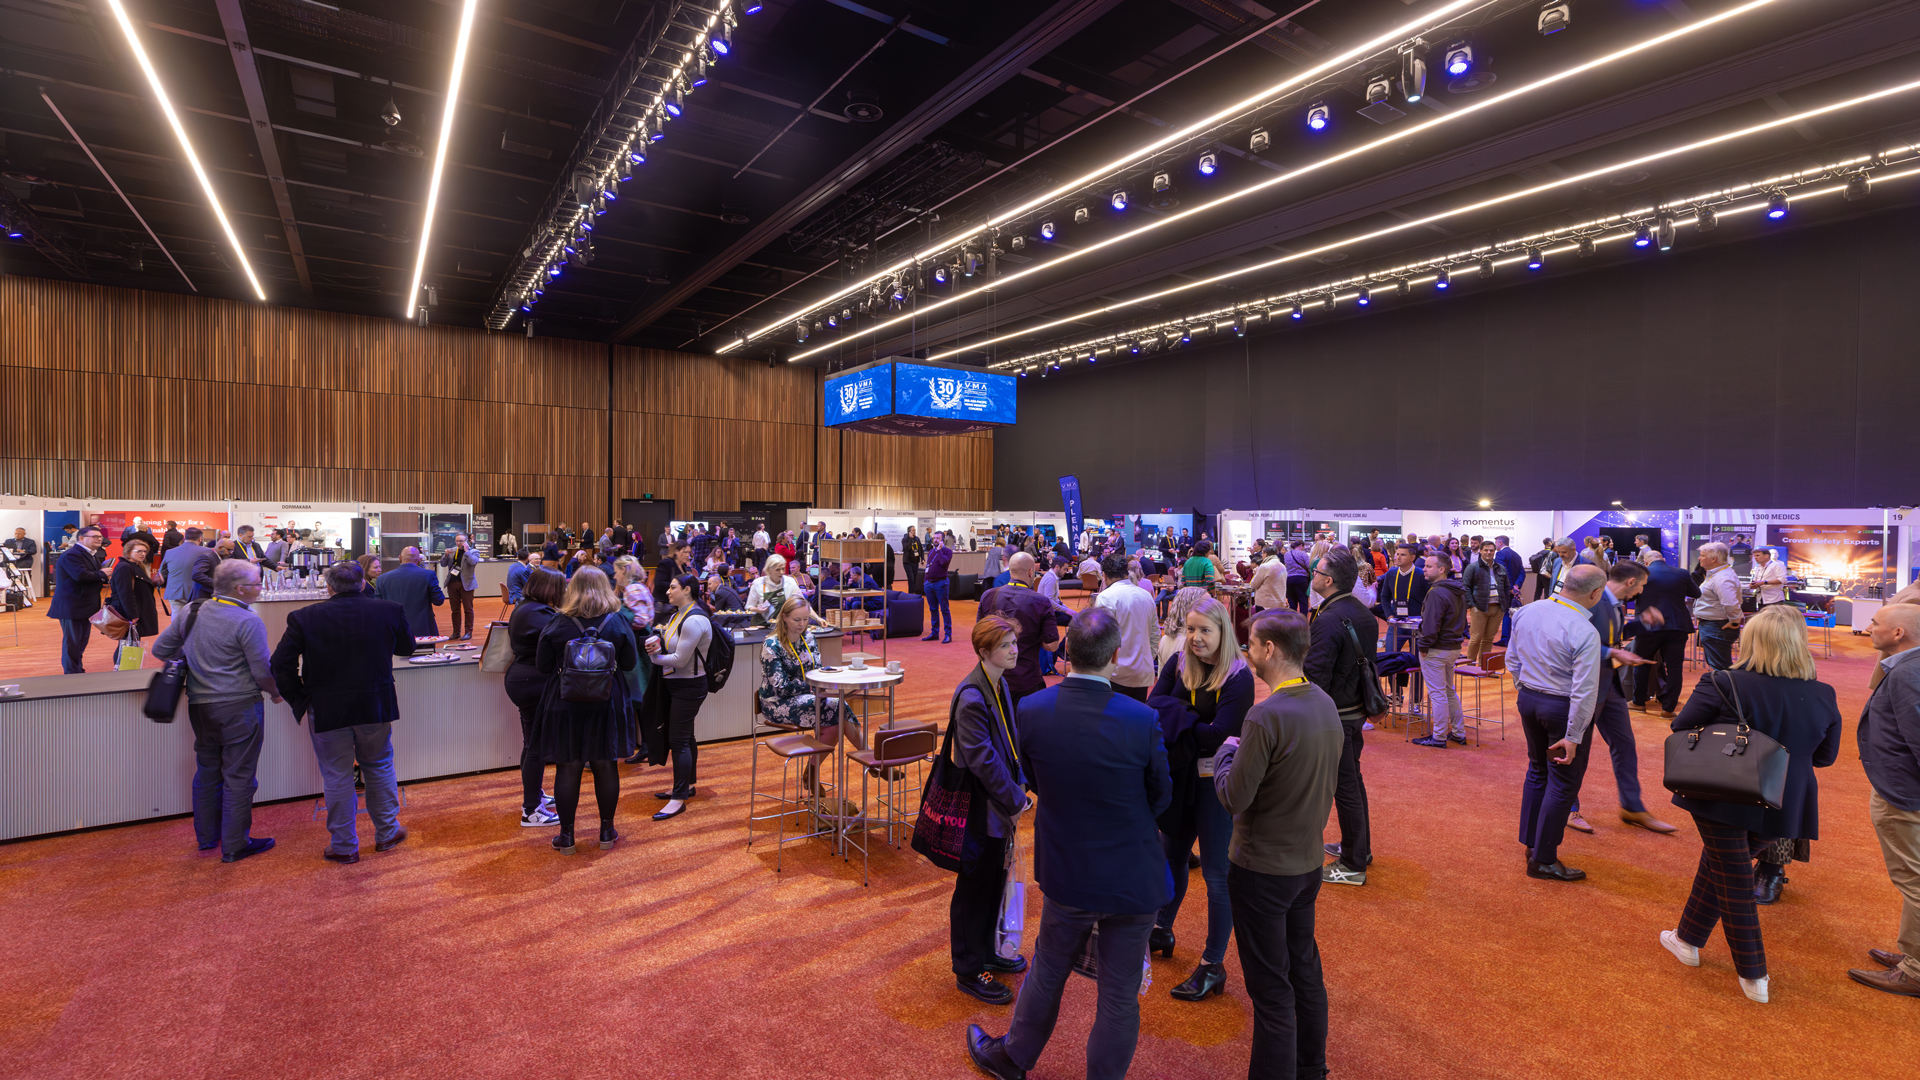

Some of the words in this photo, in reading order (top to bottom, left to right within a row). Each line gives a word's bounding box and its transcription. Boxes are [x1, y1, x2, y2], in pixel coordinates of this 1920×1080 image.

[844, 386, 853, 400] 30
[938, 382, 954, 395] 30
[944, 816, 967, 828] YOU
